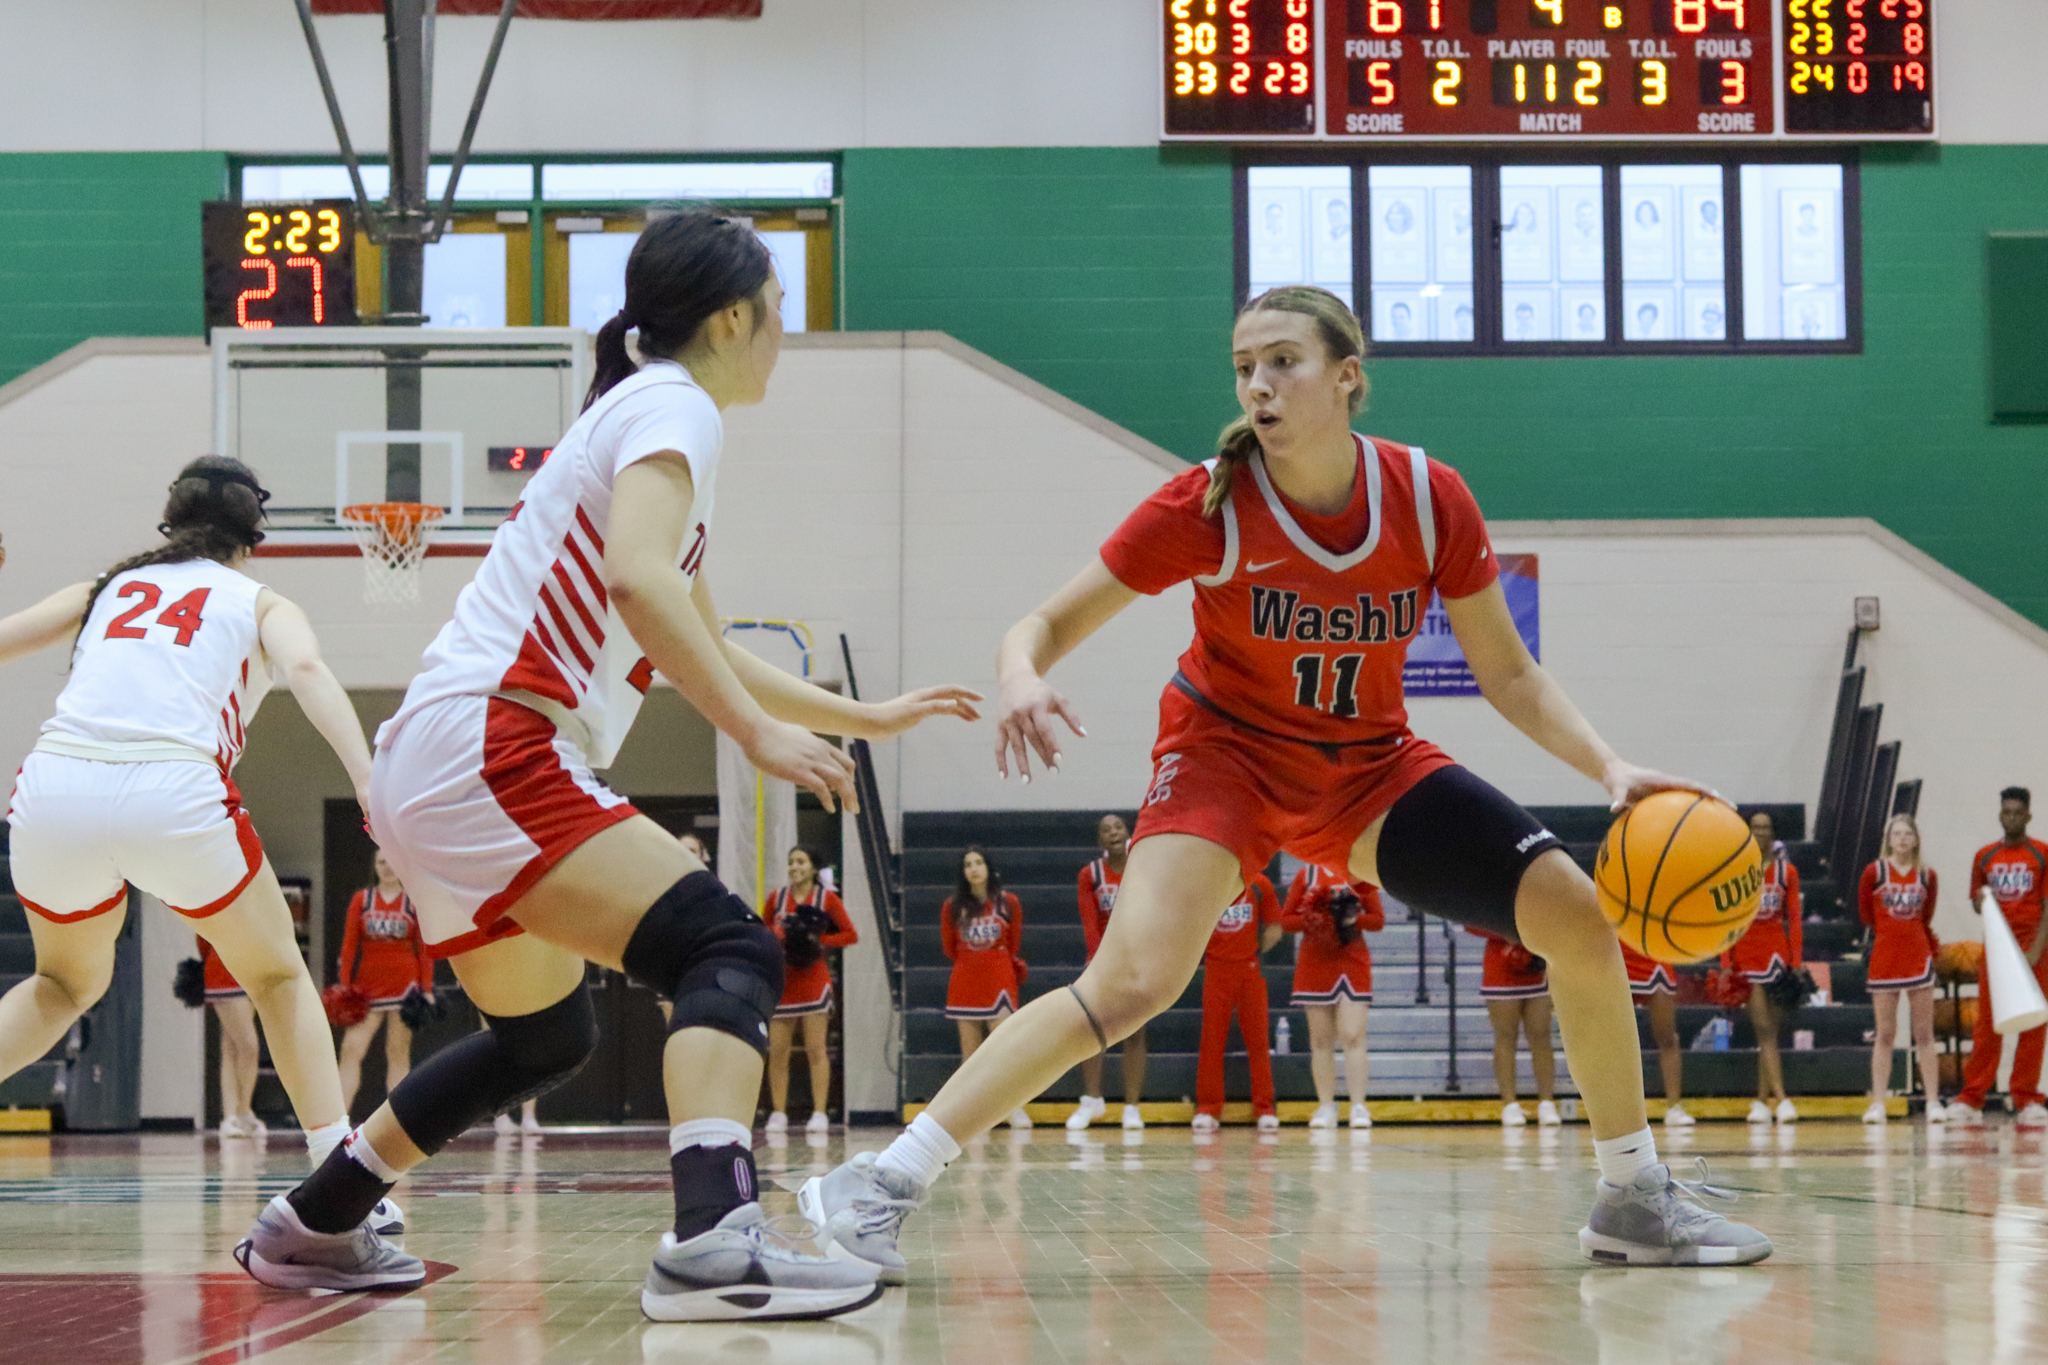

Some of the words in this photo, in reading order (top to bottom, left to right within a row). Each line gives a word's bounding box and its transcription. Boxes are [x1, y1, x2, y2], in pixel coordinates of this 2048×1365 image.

[1174, 22, 1217, 55] 30
[1232, 23, 1251, 55] 3
[1286, 23, 1307, 54] 8
[1345, 40, 1403, 58] FOULS
[1421, 39, 1470, 58] T.O.L.
[1488, 39, 1556, 58] PLAYER
[1565, 39, 1611, 58] FOUL
[1628, 39, 1677, 58] T.O.L.
[1695, 38, 1753, 58] FOULS
[1789, 22, 1833, 55] 23
[1847, 22, 1867, 55] 2
[1904, 22, 1924, 54] 8
[1175, 61, 1217, 95] 33
[1230, 61, 1251, 94] 2
[1264, 61, 1309, 95] 23
[1367, 62, 1395, 105] 5
[1432, 61, 1461, 105] 2
[1641, 60, 1667, 105] 3
[1720, 61, 1746, 105] 3
[1790, 61, 1834, 94] 24
[1848, 61, 1868, 94] 0
[1893, 61, 1925, 91] 19
[1346, 113, 1404, 132] SCORE
[1519, 113, 1582, 131] MATCH
[1698, 112, 1756, 132] SCORE
[244, 209, 341, 255] 2:23
[237, 256, 323, 331] 27
[103, 580, 212, 648] 24
[1250, 584, 1419, 644] WashU
[1293, 653, 1366, 718] 11
[1220, 905, 1252, 919] ASH
